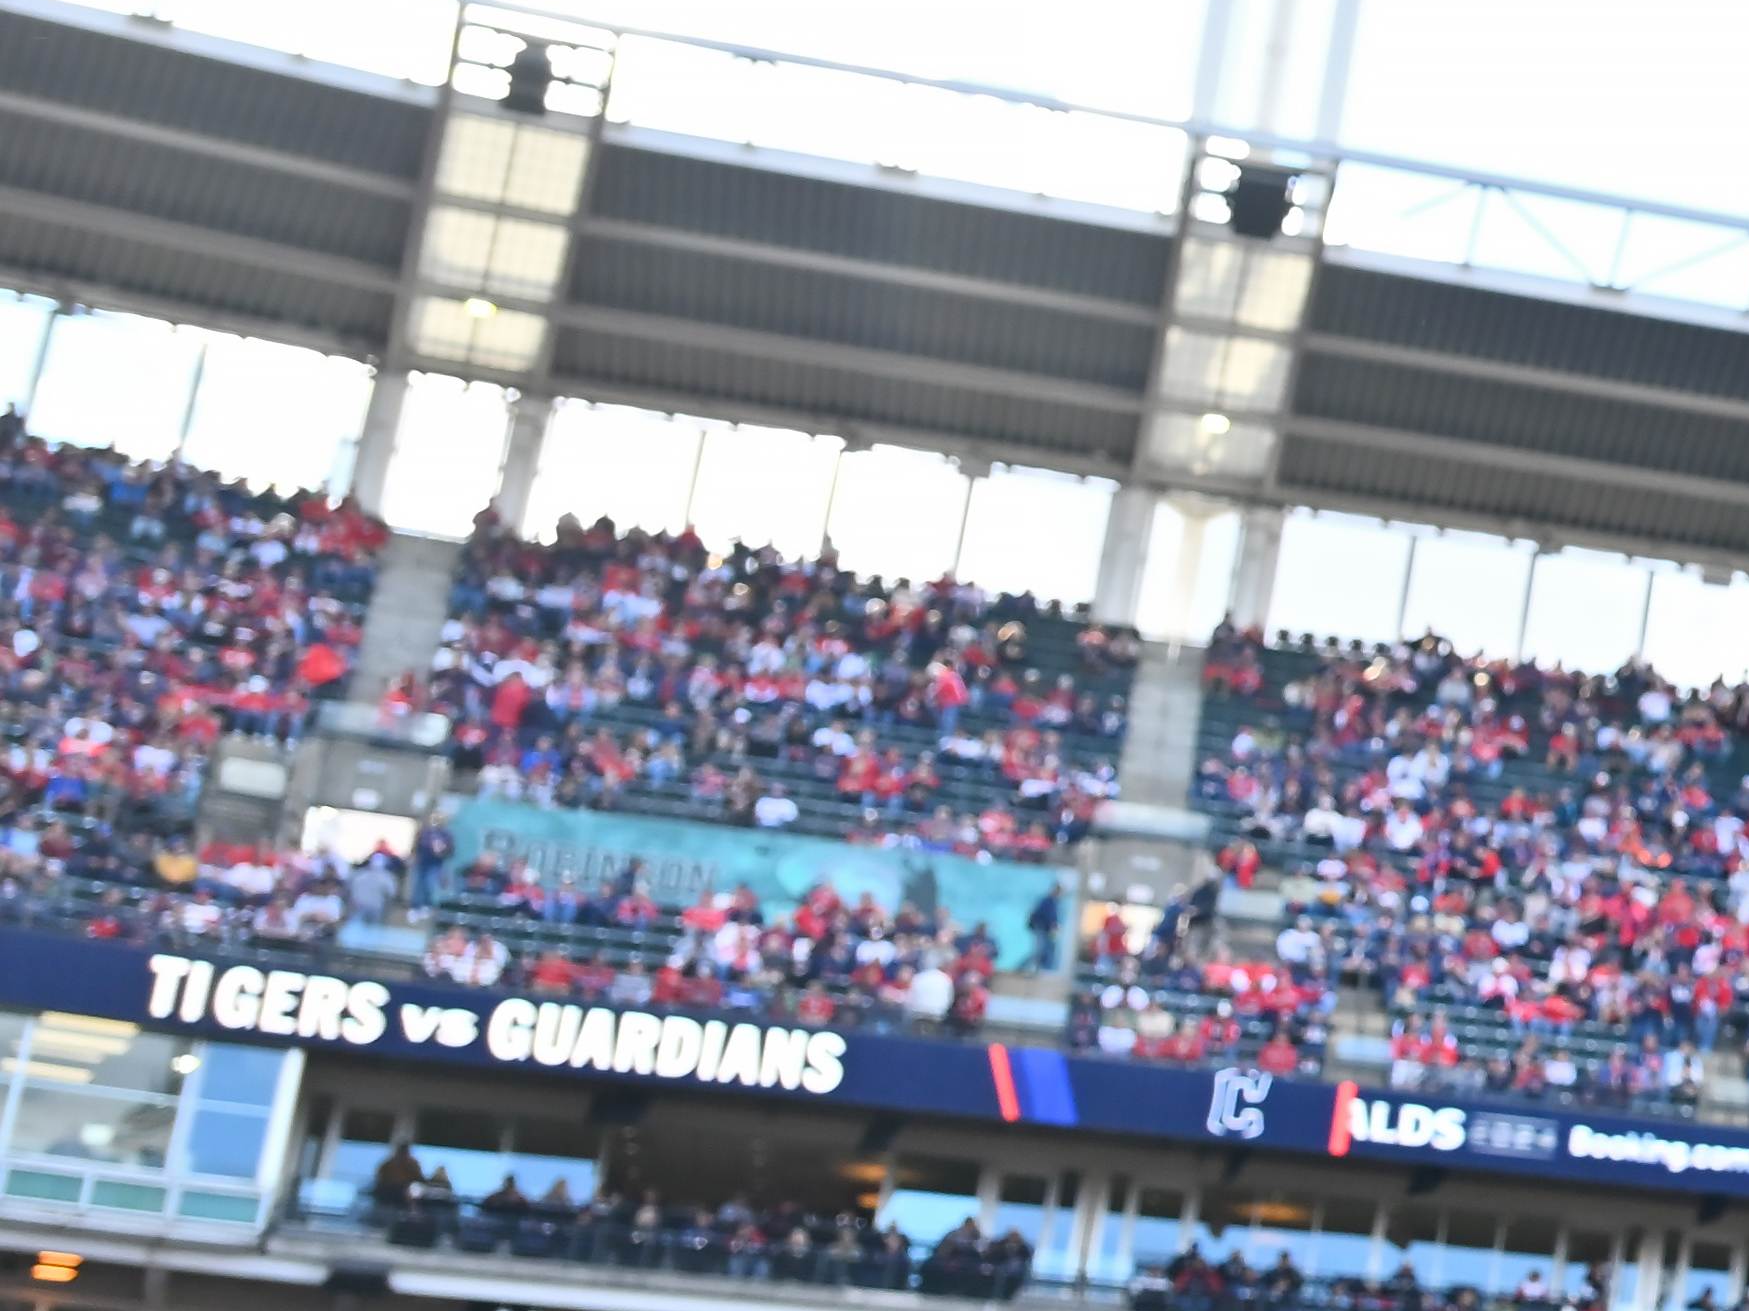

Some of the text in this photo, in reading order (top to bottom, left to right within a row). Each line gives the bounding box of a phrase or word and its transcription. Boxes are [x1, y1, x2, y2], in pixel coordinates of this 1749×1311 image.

[149, 954, 848, 1094] TIGERS vs GUARDIANS
